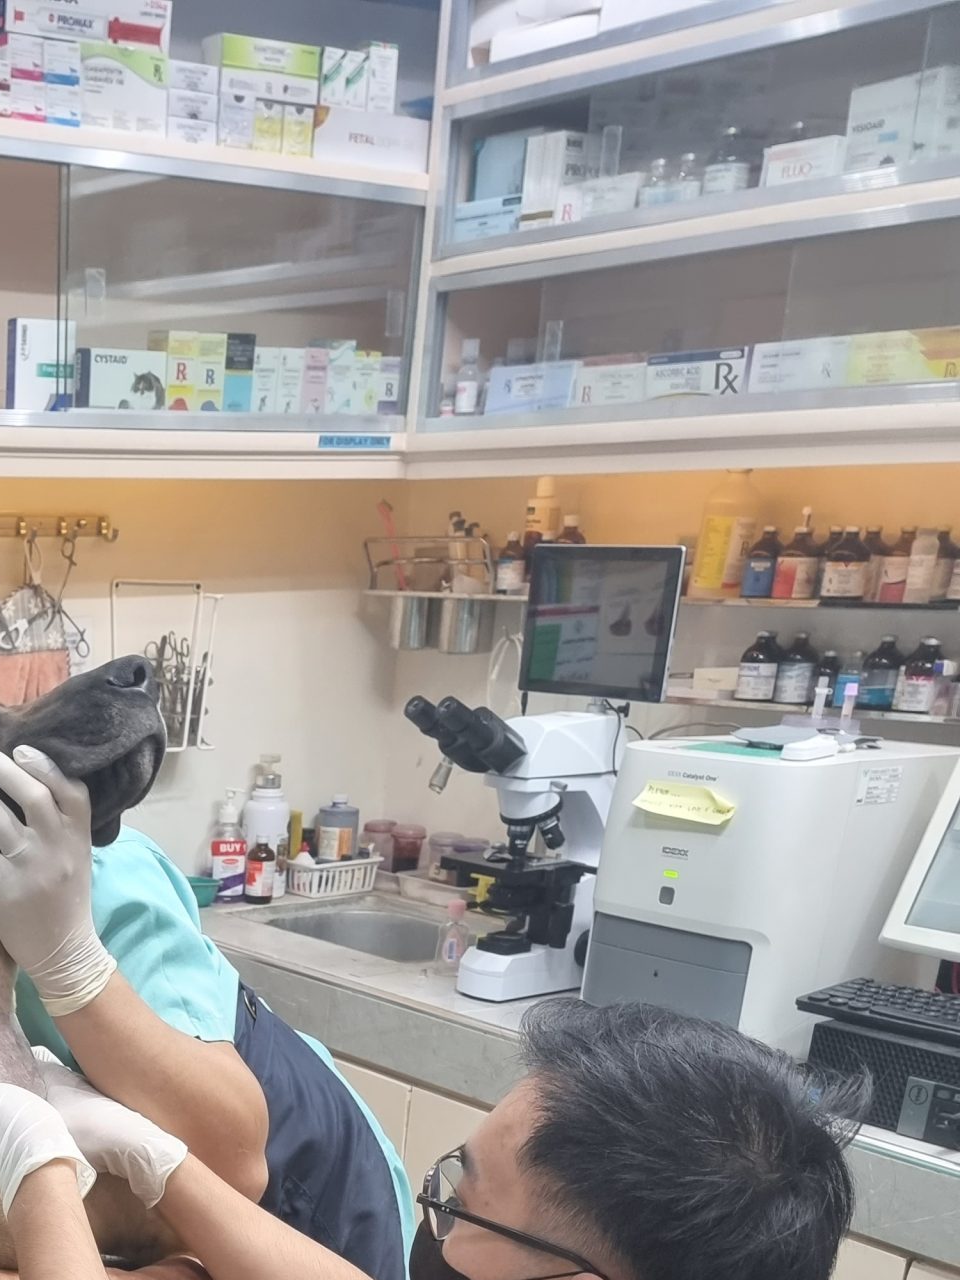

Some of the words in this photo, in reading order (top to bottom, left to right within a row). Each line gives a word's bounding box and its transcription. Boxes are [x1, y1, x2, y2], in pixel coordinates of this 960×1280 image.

[93, 353, 129, 365] CYSTAID
[682, 771, 705, 781] Catalyst
[705, 774, 718, 782] One
[219, 843, 240, 853] BUY
